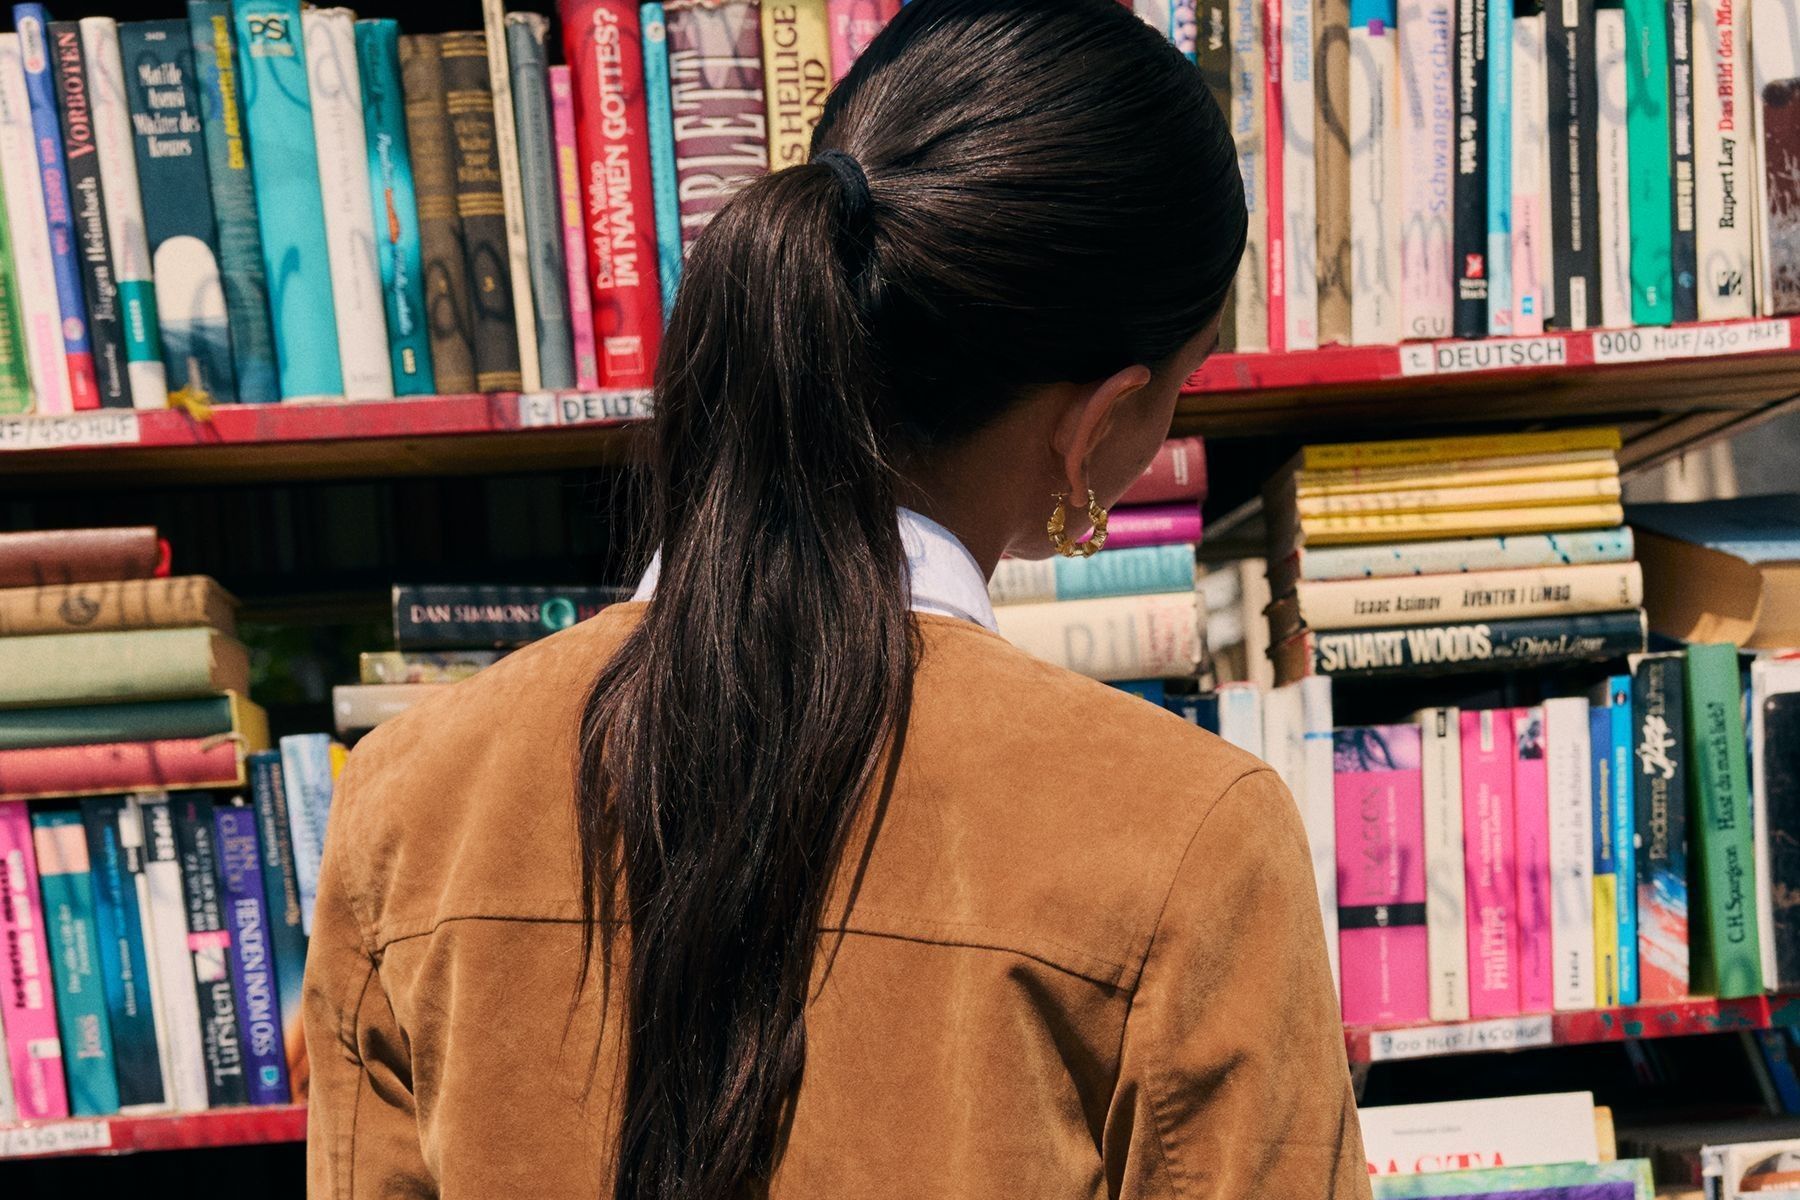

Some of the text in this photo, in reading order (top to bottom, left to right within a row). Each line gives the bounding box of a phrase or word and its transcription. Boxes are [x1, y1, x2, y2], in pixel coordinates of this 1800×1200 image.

[249, 17, 292, 43] PSI
[1716, 28, 1733, 58] des
[1716, 62, 1733, 98] Bild
[1718, 100, 1734, 132] Das
[593, 6, 640, 287] IM NAMEN GOTTES?
[1716, 136, 1736, 157] Lay
[588, 160, 608, 216] Yallop
[1718, 156, 1737, 229] Rupert
[594, 242, 615, 289] David
[1437, 340, 1563, 369] DEUTSCH
[1599, 332, 1641, 355] 900
[410, 604, 541, 624] DAN SIMMONS
[1355, 599, 1390, 615] Isaac
[1395, 596, 1441, 613] Asimov
[1319, 630, 1405, 672] STUART
[1712, 773, 1731, 791] du
[1713, 795, 1735, 830] Hast
[252, 1019, 276, 1057] OSS
